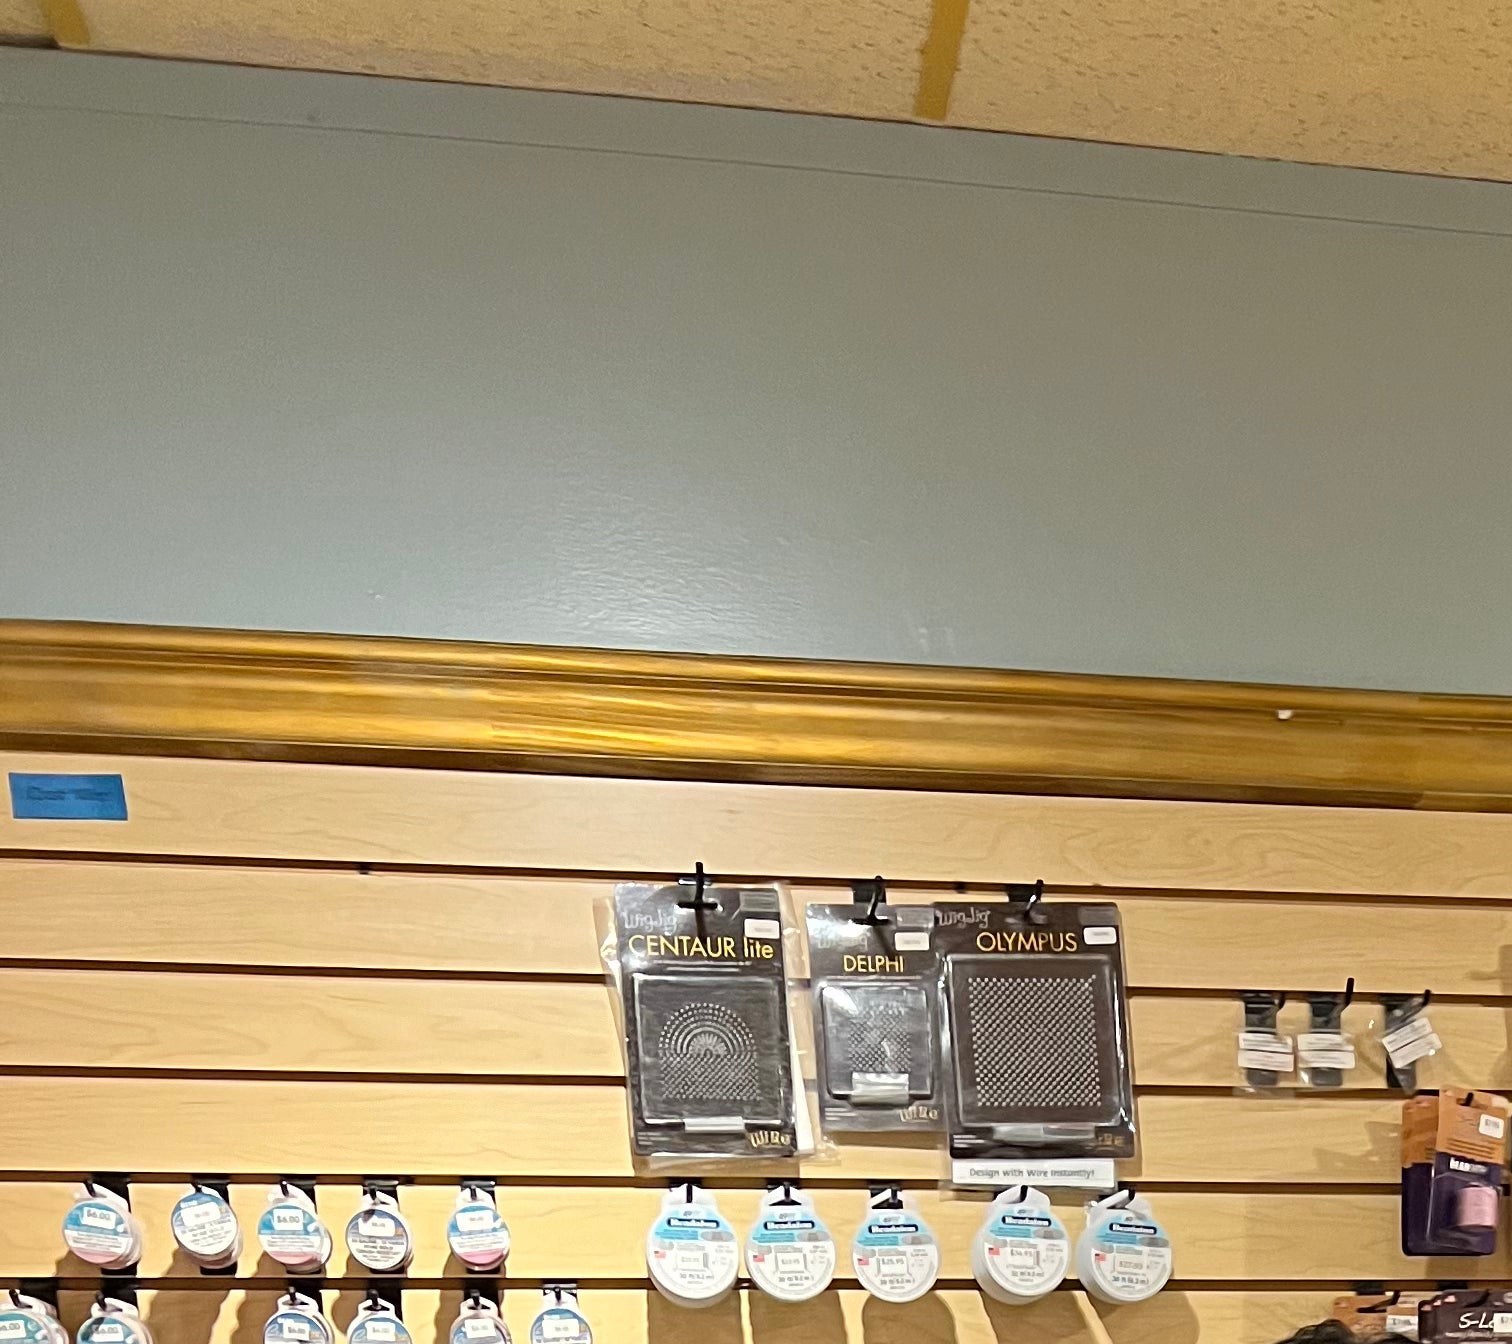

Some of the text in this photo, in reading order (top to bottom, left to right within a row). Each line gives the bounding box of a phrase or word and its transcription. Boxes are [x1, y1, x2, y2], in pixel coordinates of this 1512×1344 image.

[628, 934, 774, 960] CENTAUR lite
[976, 932, 1078, 952] OLYMPUS
[843, 955, 904, 973] DELPHI
[969, 1168, 999, 1180] Design
[1002, 1168, 1023, 1178] with
[1027, 1168, 1048, 1178] Wire
